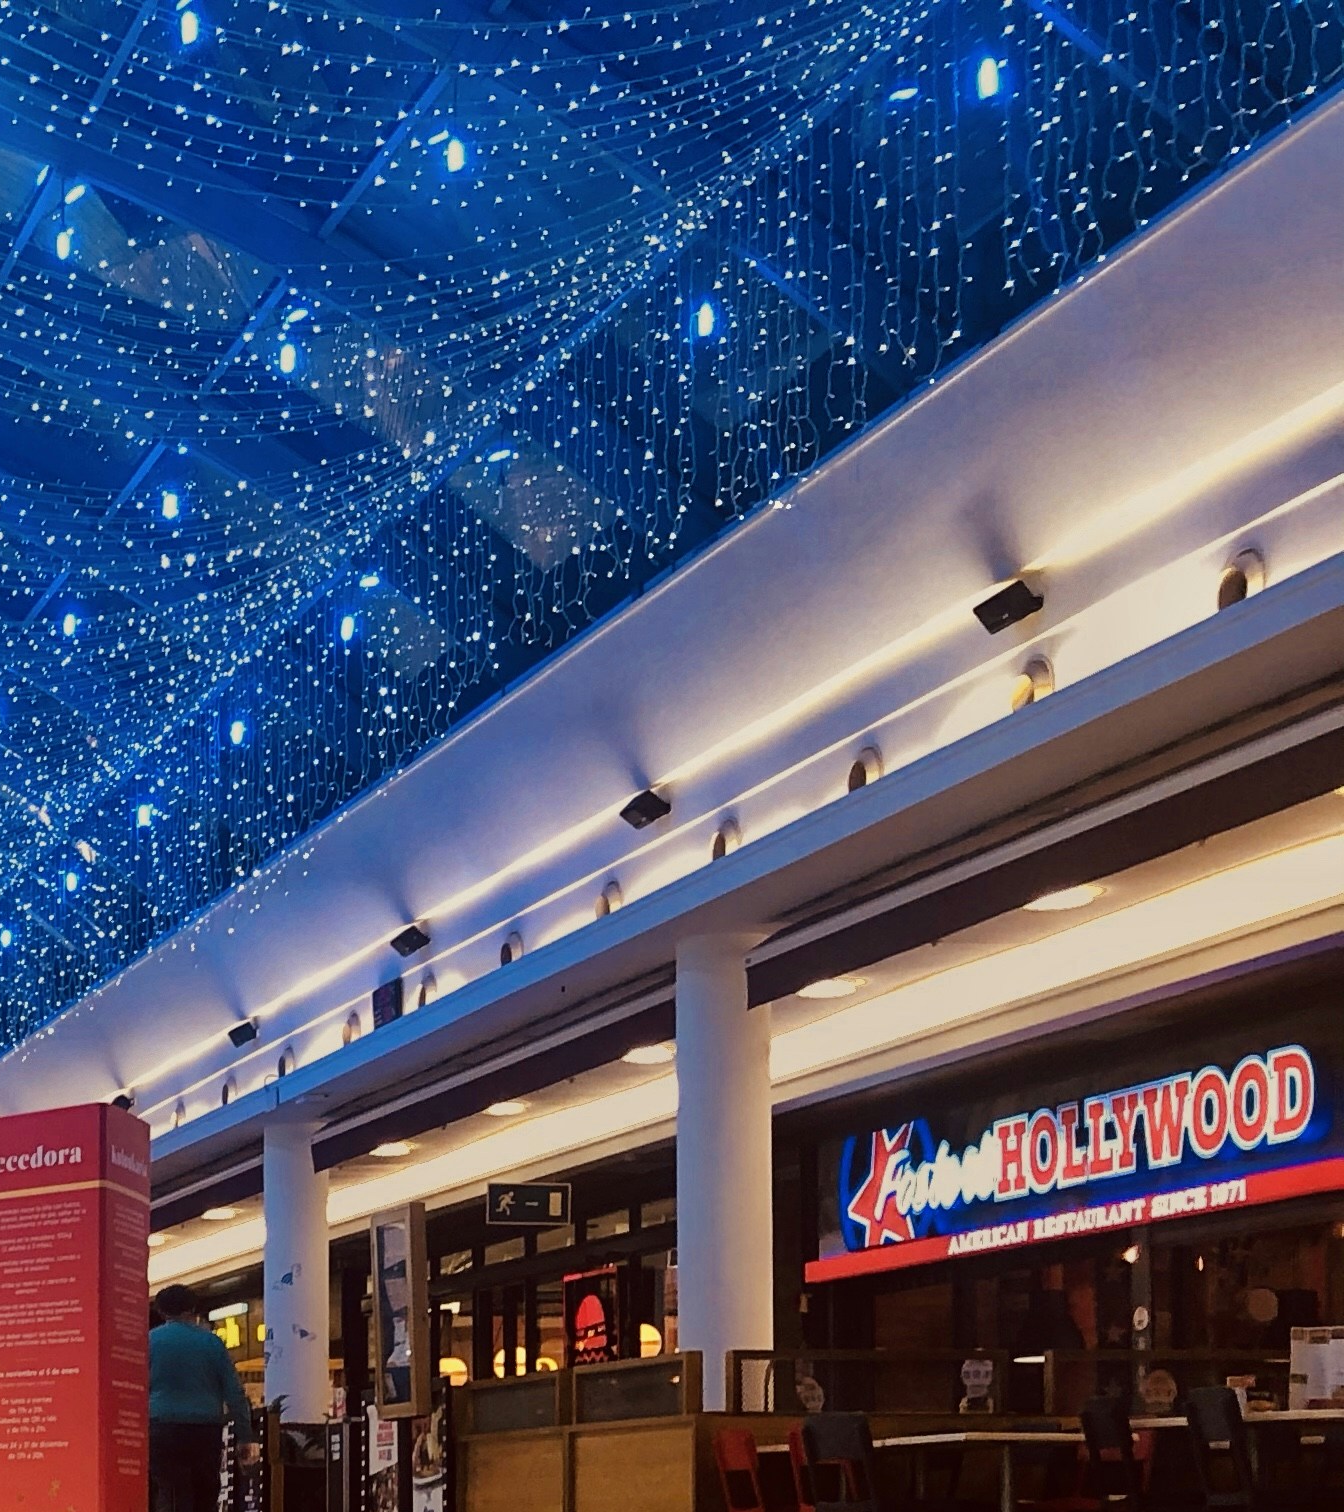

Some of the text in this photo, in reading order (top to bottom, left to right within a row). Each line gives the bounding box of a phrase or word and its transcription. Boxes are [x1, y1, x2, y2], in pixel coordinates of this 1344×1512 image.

[994, 1045, 1314, 1201] HOLLYWOOD
[947, 1221, 1028, 1256] AMERICAN
[1032, 1198, 1146, 1239] RESTAURANT
[1150, 1184, 1208, 1217] SINCE
